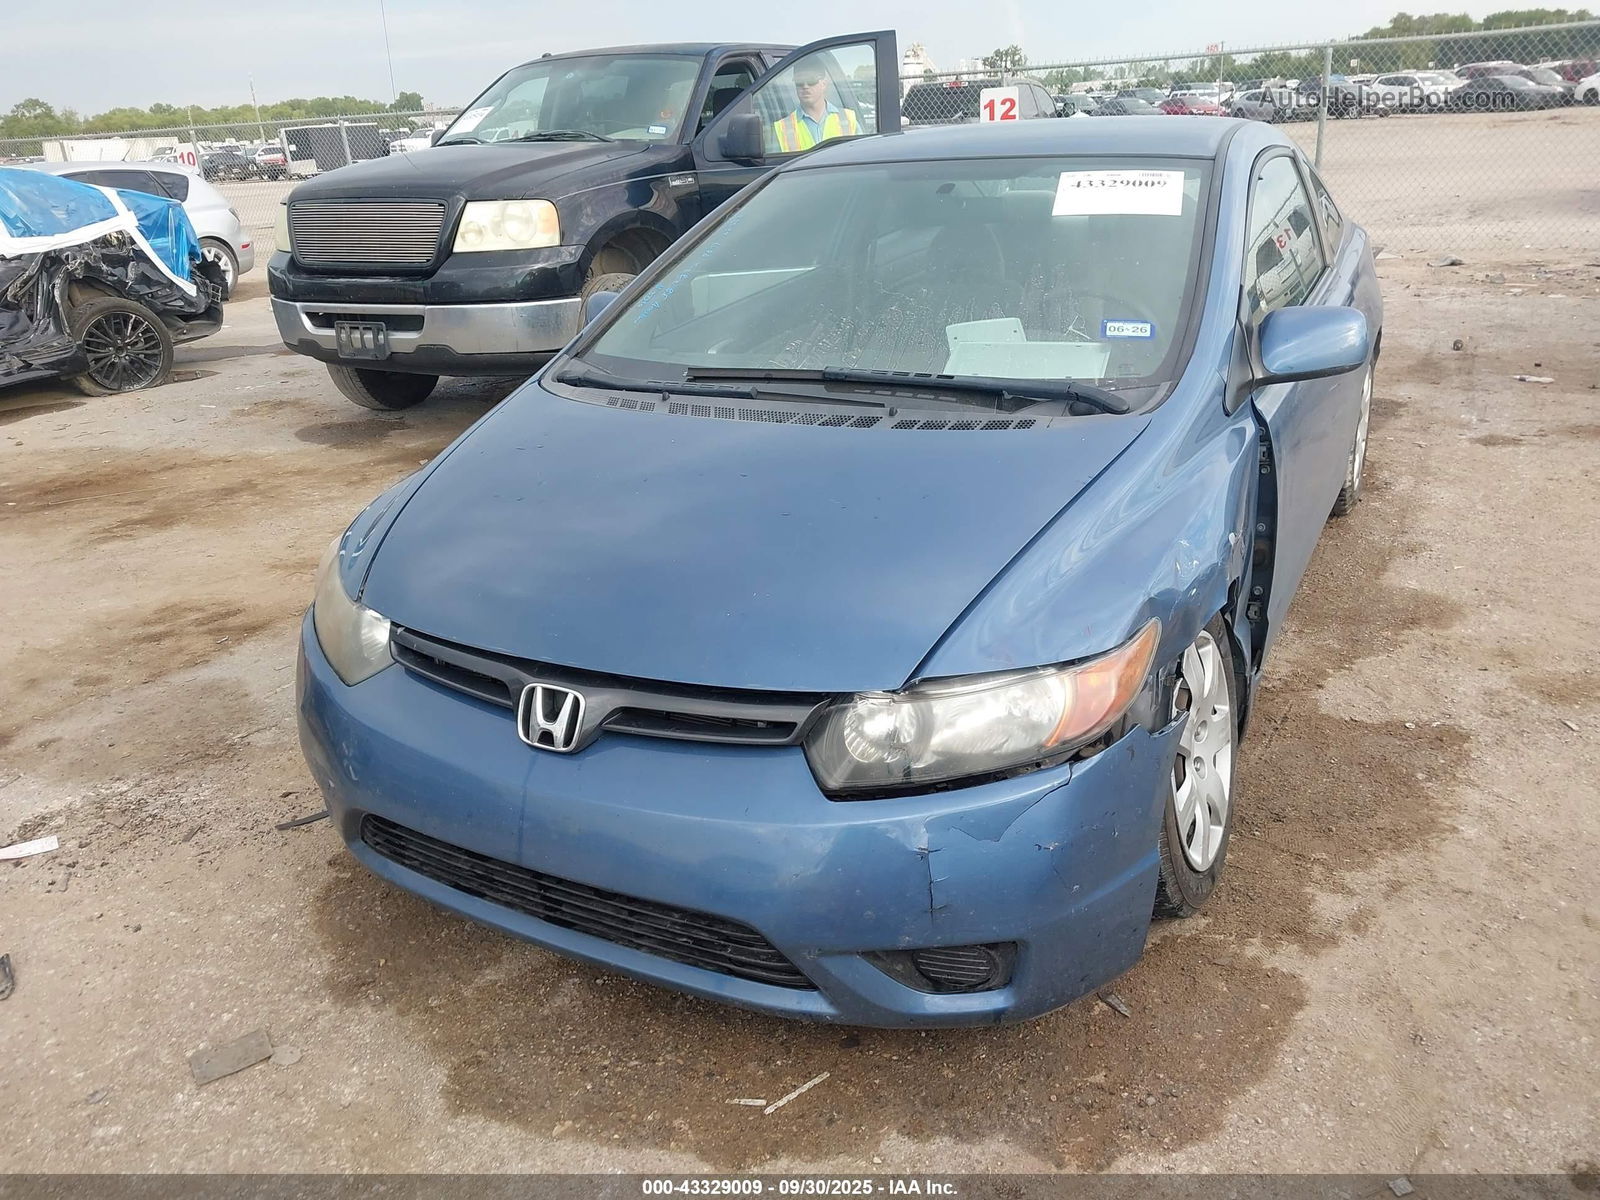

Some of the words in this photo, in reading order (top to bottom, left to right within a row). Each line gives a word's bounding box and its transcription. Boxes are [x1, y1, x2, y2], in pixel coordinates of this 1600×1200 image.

[983, 97, 1017, 121] 12
[178, 151, 196, 167] 10
[1070, 179, 1168, 189] 43329009
